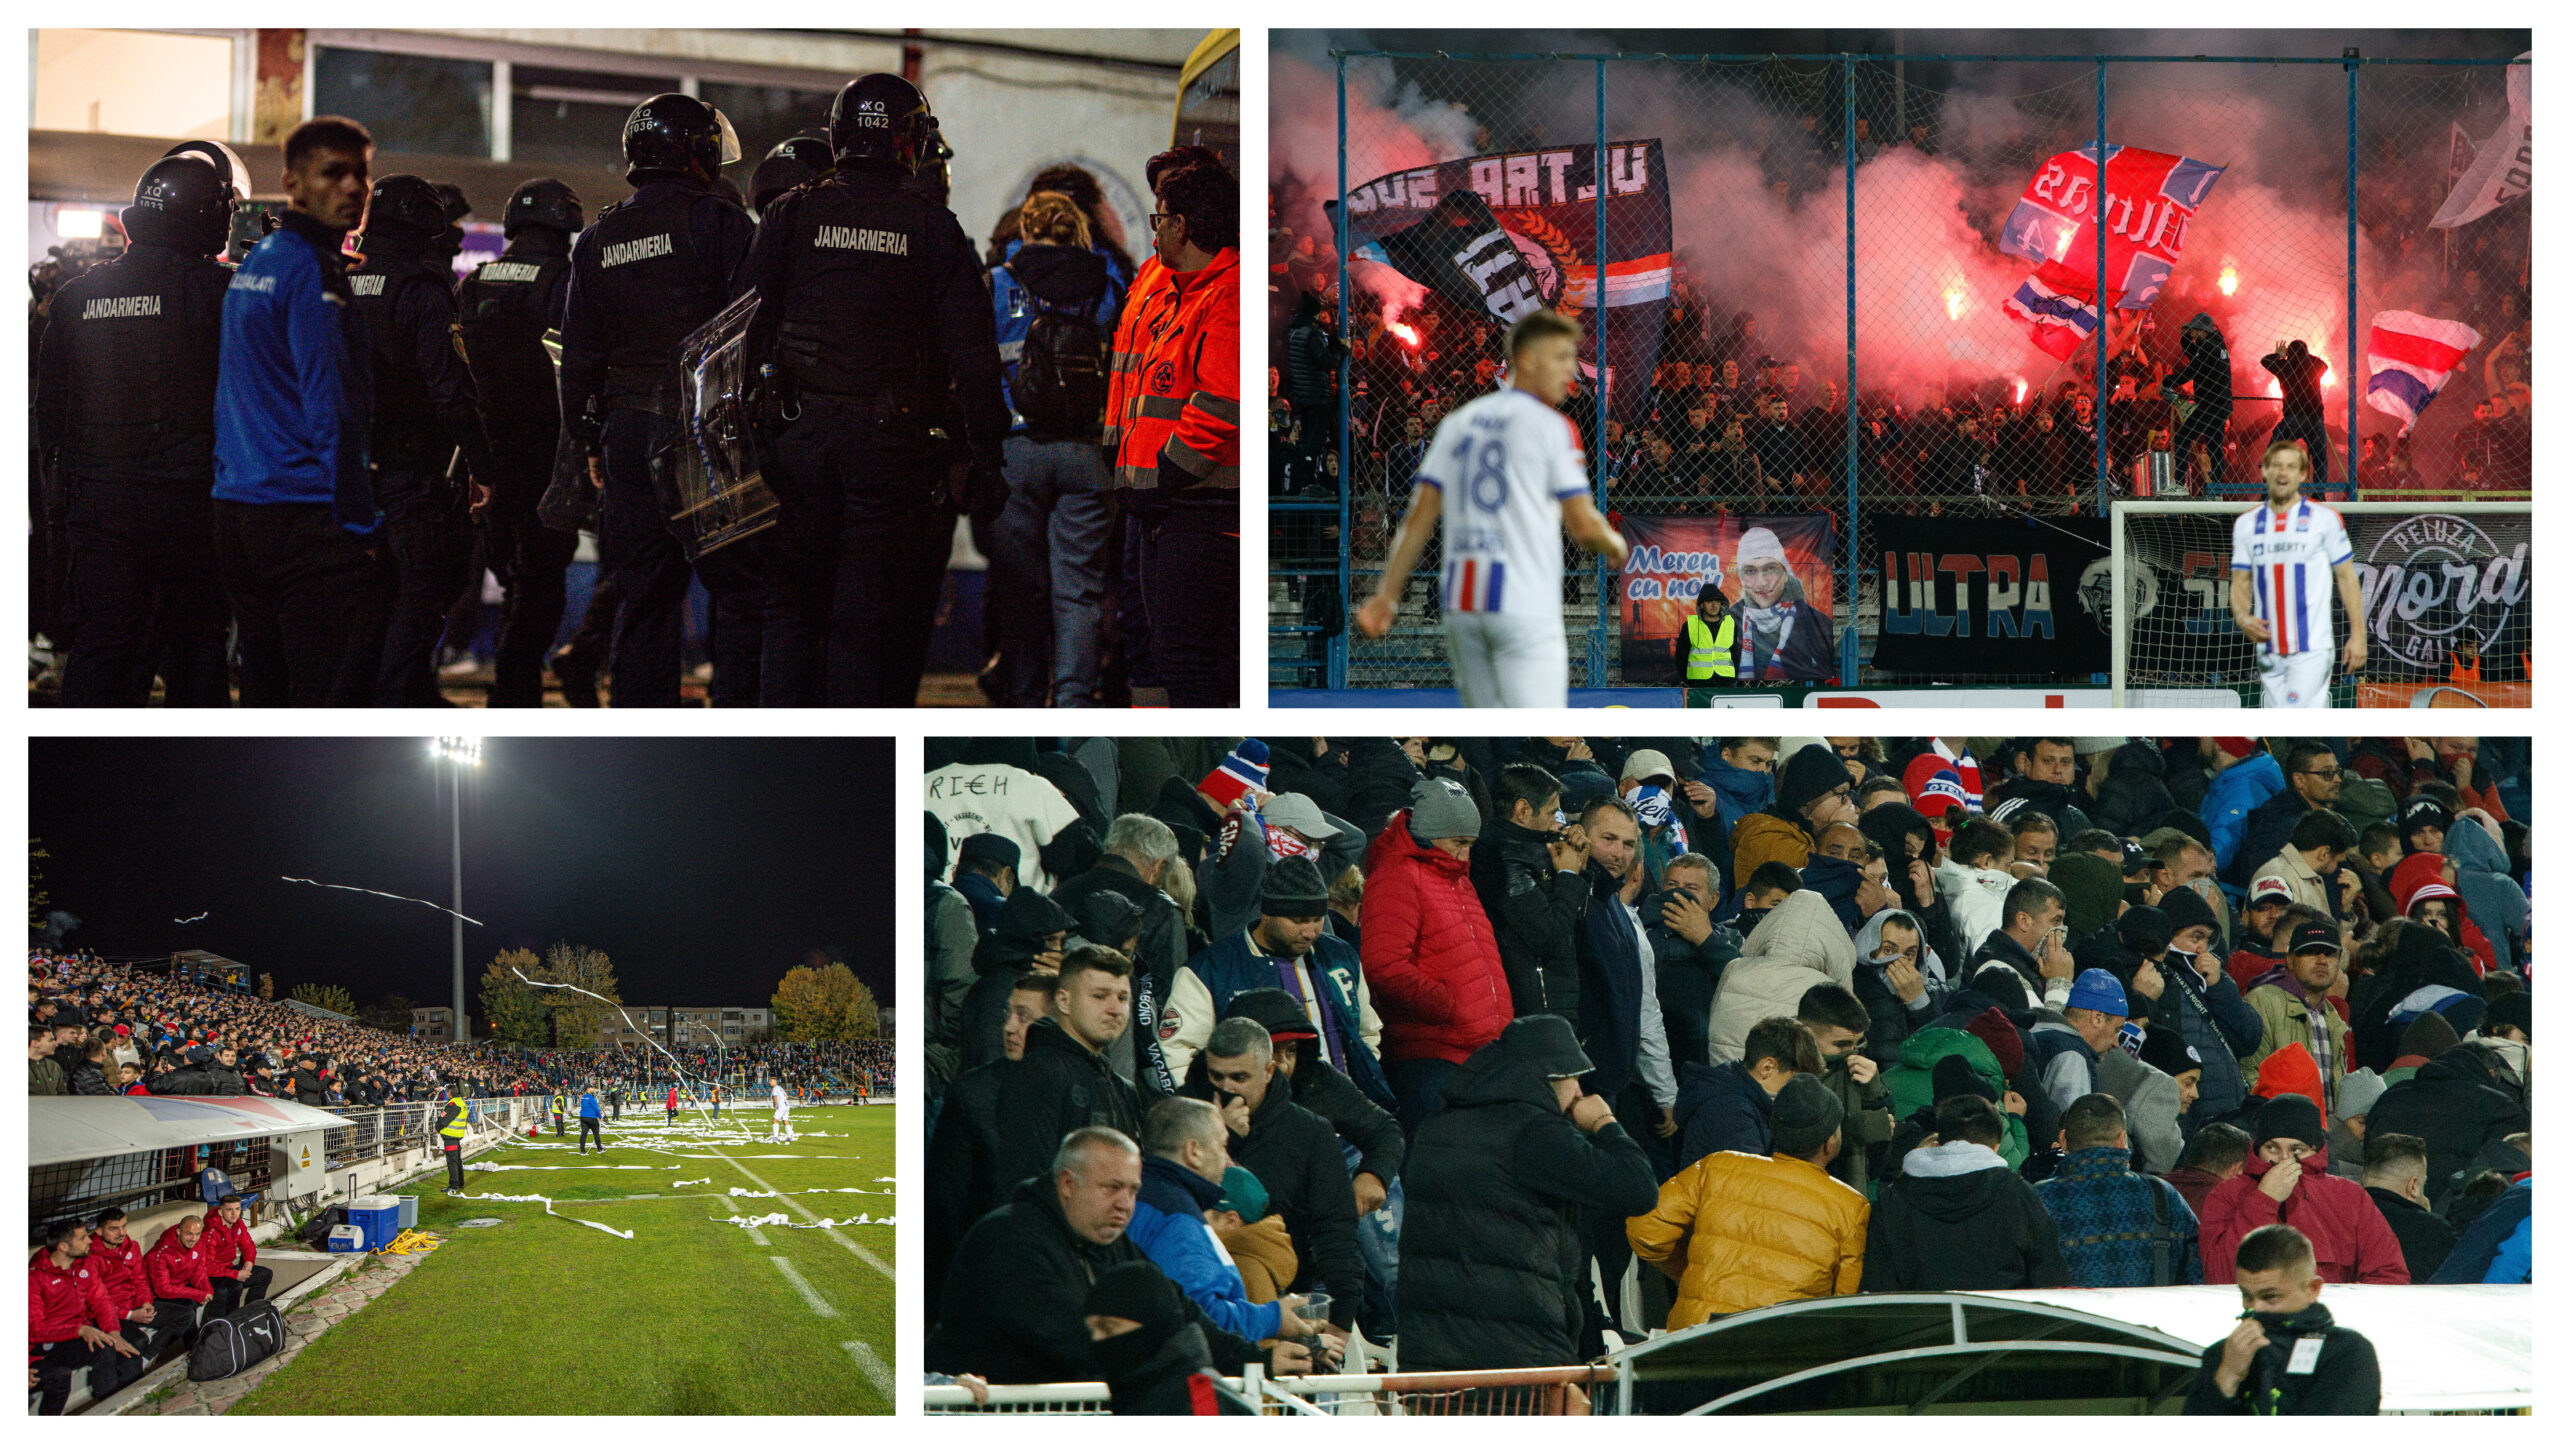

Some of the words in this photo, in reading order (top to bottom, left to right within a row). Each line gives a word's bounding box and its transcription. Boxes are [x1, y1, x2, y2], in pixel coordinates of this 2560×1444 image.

[863, 100, 886, 113] XQ
[630, 120, 653, 135] 1036
[857, 117, 889, 129] 1042
[601, 232, 673, 269] JANDARMERIA
[814, 225, 908, 256] JANDARMERIA
[83, 295, 161, 320] JANDARMERIA
[1451, 435, 1510, 514] 18
[2267, 542, 2309, 554] LIBERTY
[2393, 519, 2477, 556] PELUZA
[1625, 545, 1720, 574] Mereu
[1627, 577, 1662, 601] cu
[1885, 551, 2055, 640] ULTRA
[2190, 992, 2208, 1015] RIGHT
